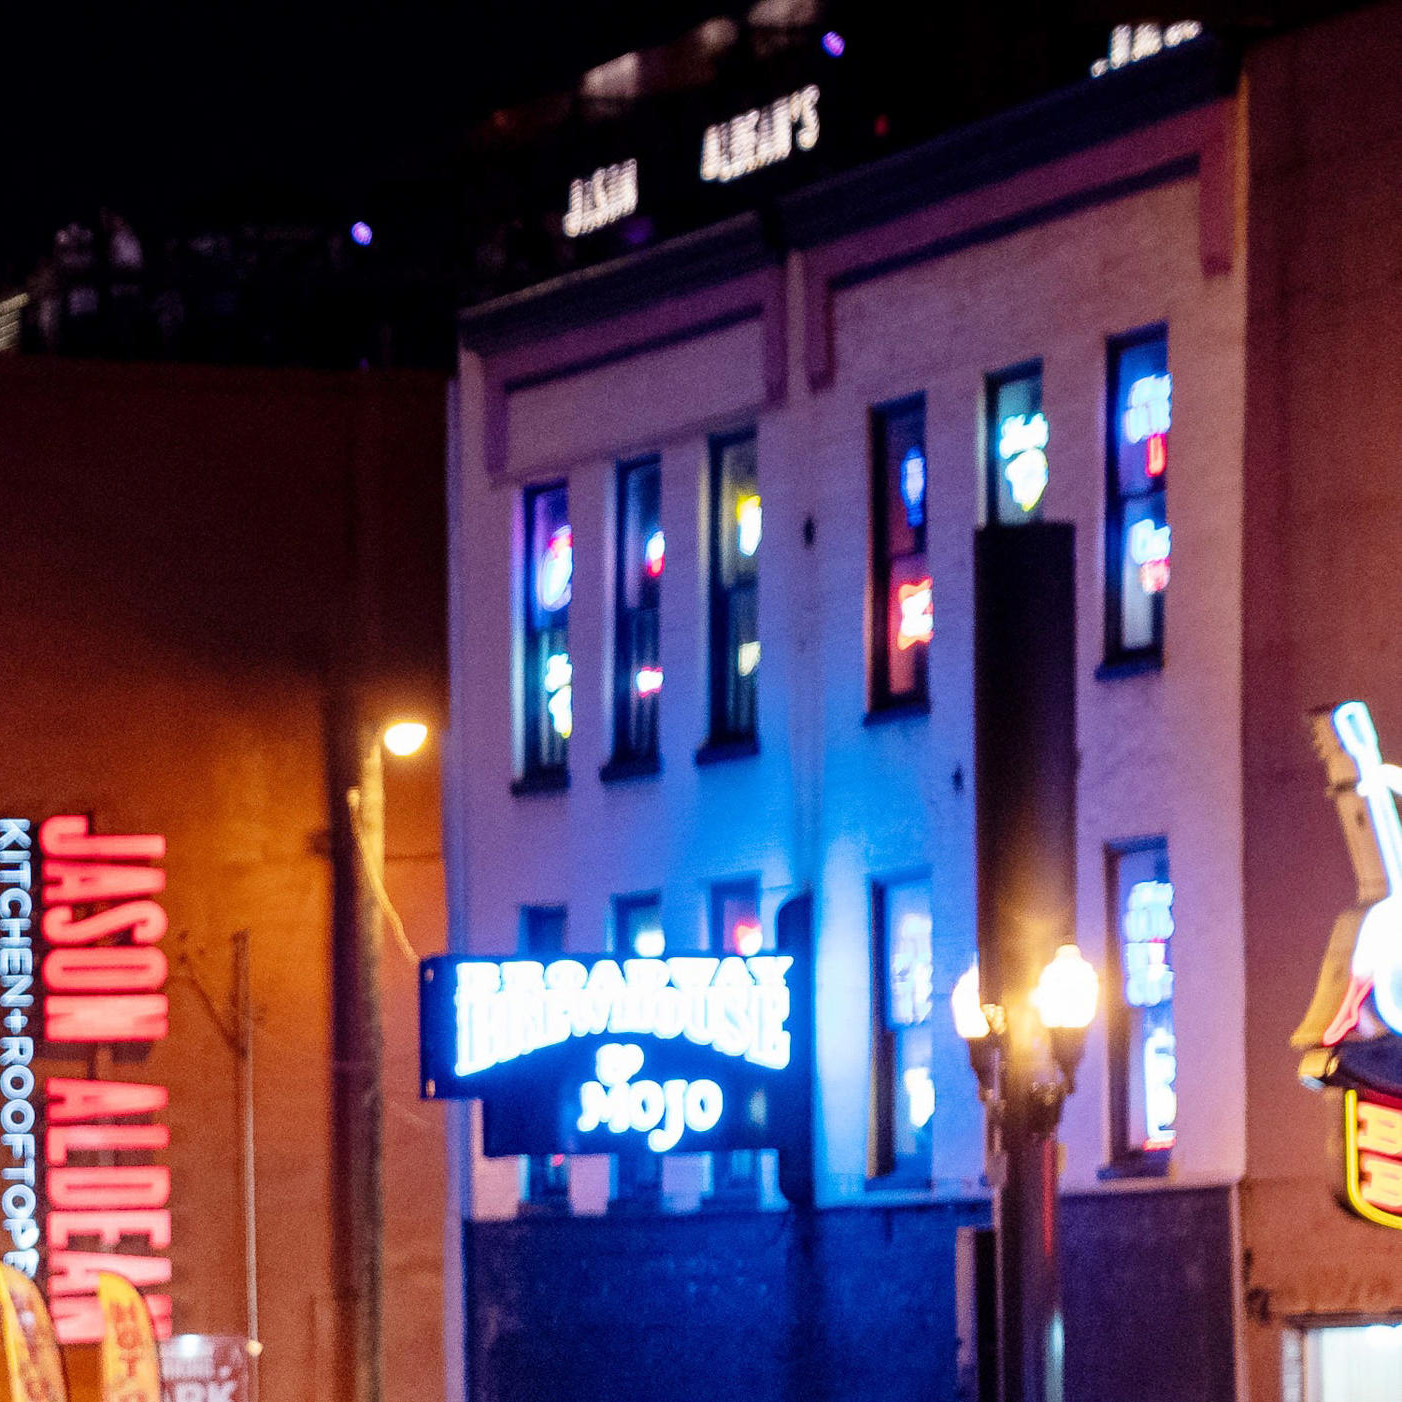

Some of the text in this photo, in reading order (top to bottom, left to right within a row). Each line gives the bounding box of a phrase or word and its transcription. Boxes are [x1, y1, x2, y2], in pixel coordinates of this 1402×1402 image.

[39, 815, 169, 1041] JASON
[455, 956, 794, 992] BROADWAY
[454, 982, 792, 1077] BREWHOUSE
